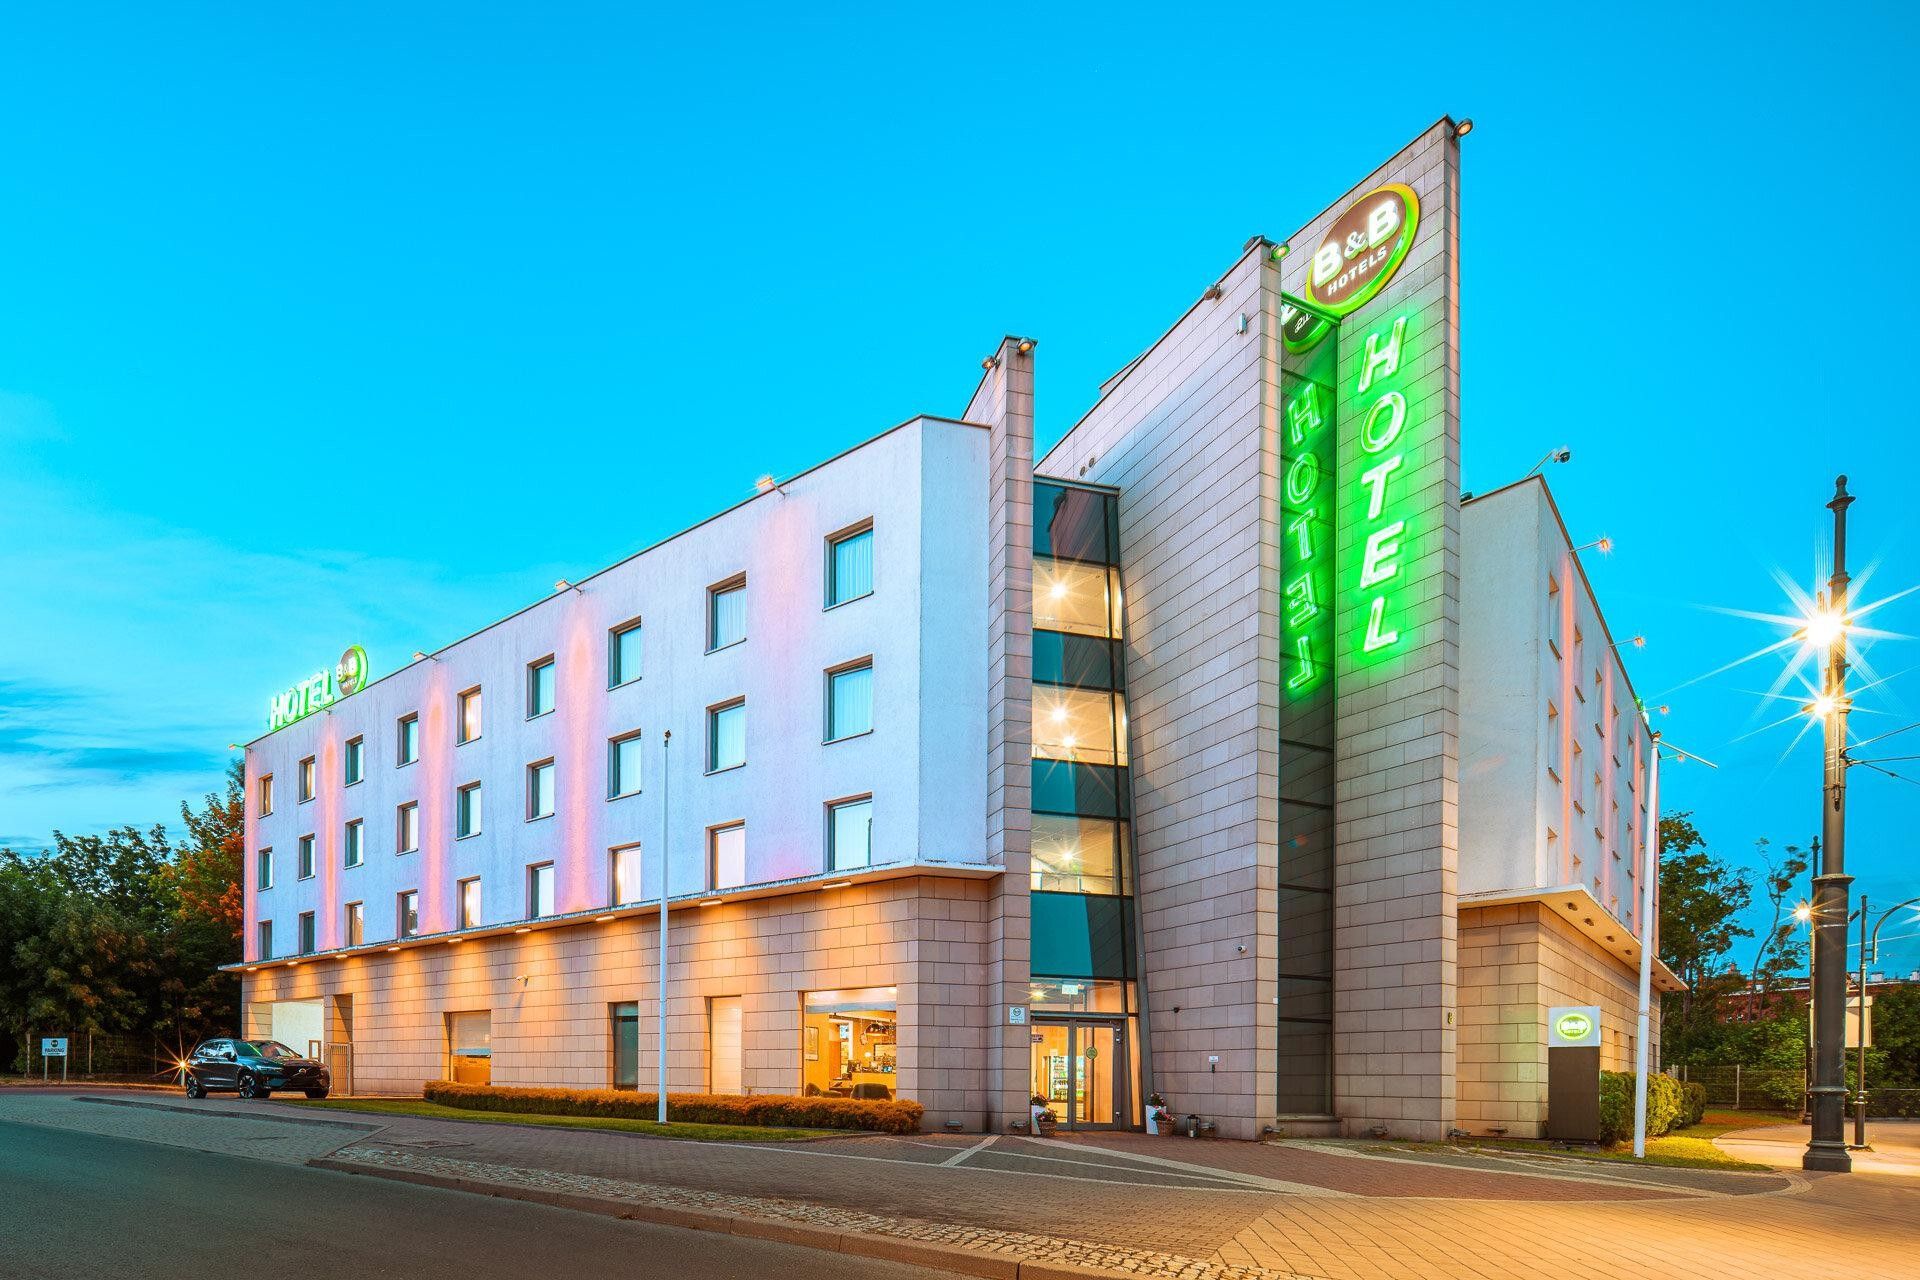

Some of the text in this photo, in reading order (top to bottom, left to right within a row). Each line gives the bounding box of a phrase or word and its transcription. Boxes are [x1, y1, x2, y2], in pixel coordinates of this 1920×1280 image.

[1314, 200, 1400, 288] B&B
[1327, 247, 1387, 297] HOTELS
[1358, 315, 1407, 652] HOTEL
[269, 668, 334, 730] HOTEL
